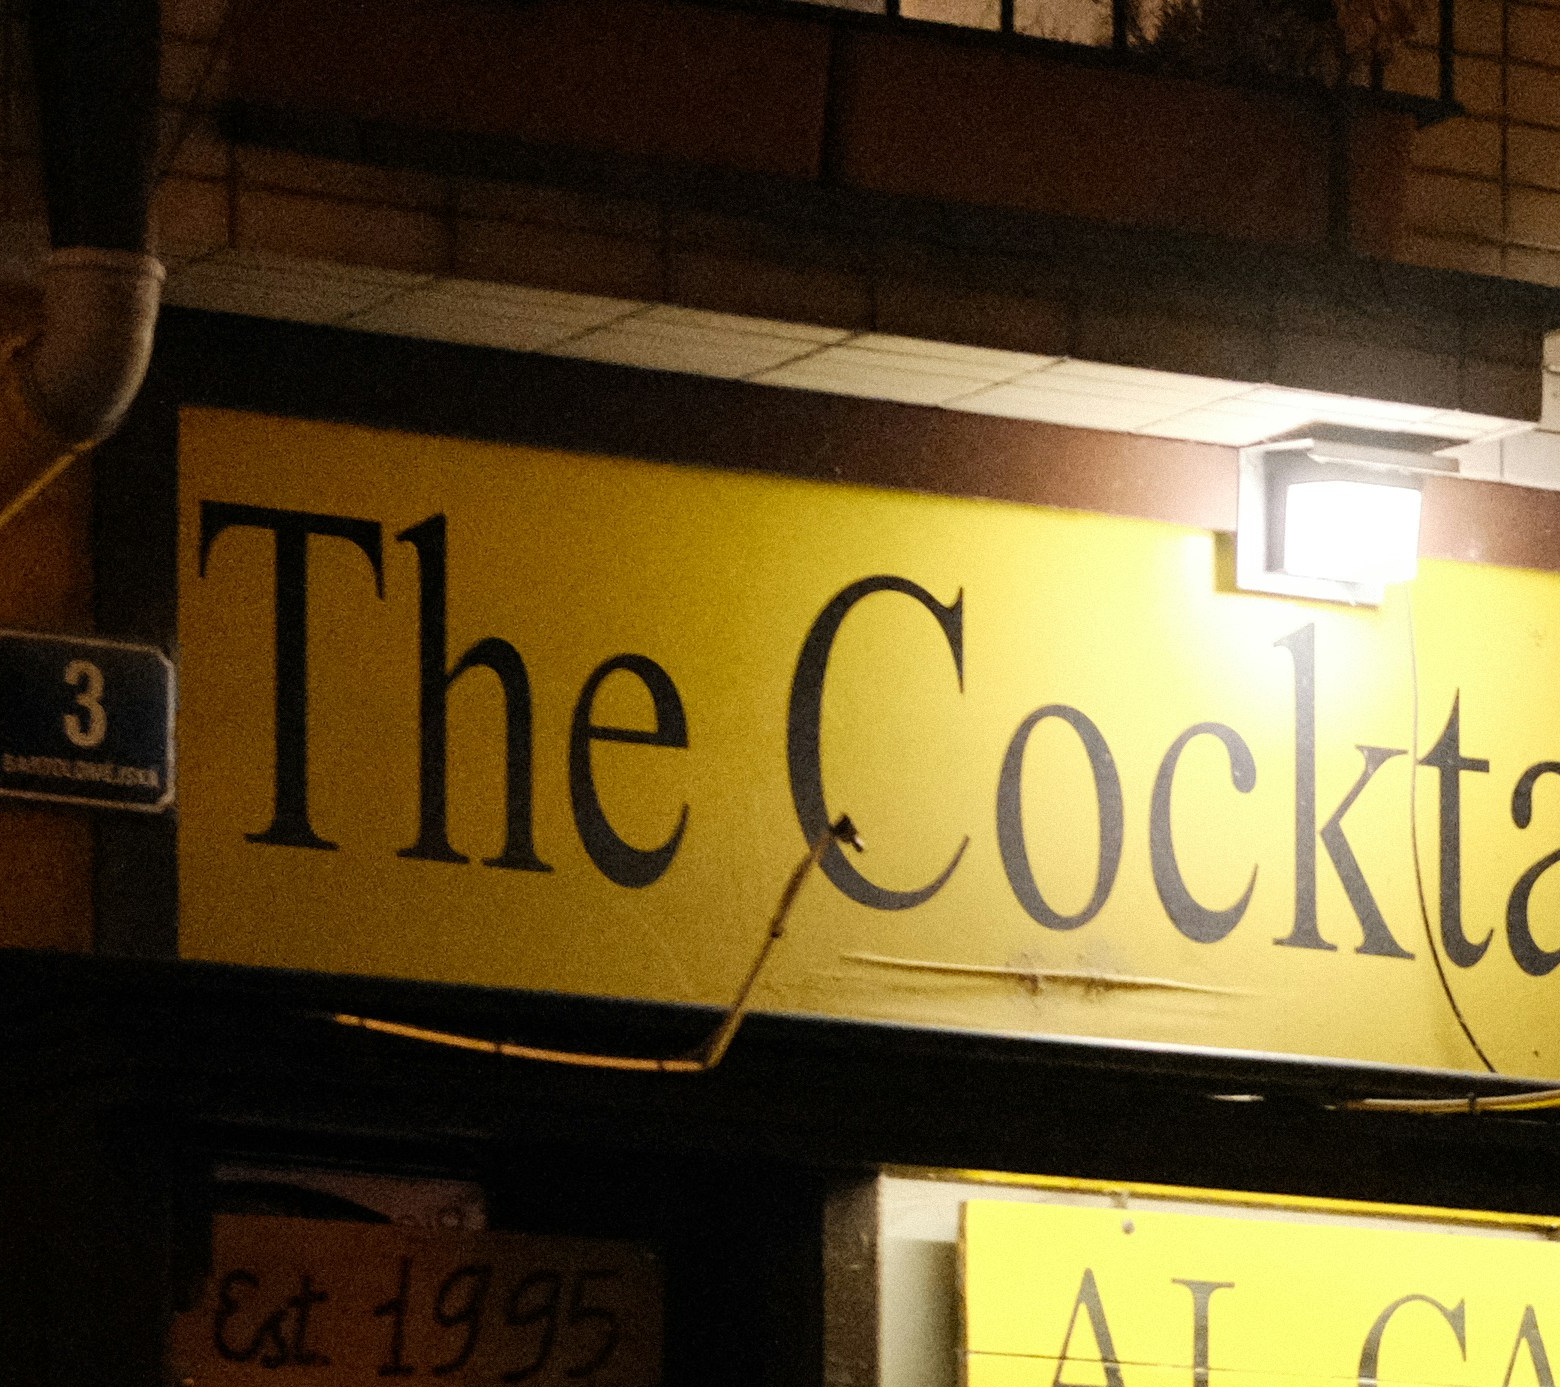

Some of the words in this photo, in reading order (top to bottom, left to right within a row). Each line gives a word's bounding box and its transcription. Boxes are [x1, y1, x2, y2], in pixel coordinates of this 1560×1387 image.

[61, 658, 109, 749] 3
[197, 495, 692, 892] The
[214, 1268, 331, 1370] Est
[375, 1254, 622, 1384] 1995
